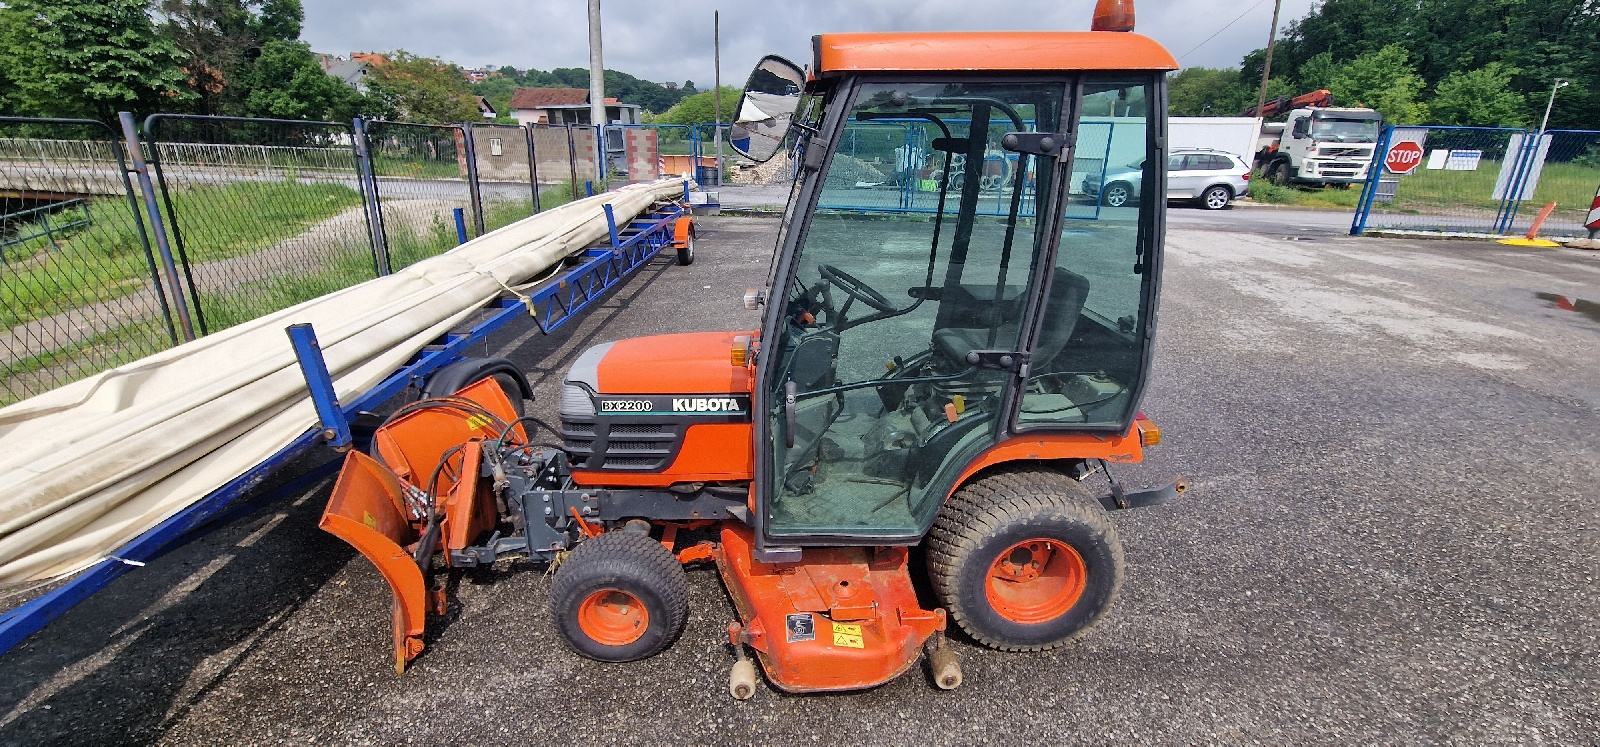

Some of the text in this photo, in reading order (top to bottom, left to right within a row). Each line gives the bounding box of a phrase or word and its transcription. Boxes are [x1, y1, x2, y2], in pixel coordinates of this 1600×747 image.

[1388, 149, 1420, 164] STOP
[602, 400, 653, 412] BX2200
[672, 398, 740, 412] KUBOTA
